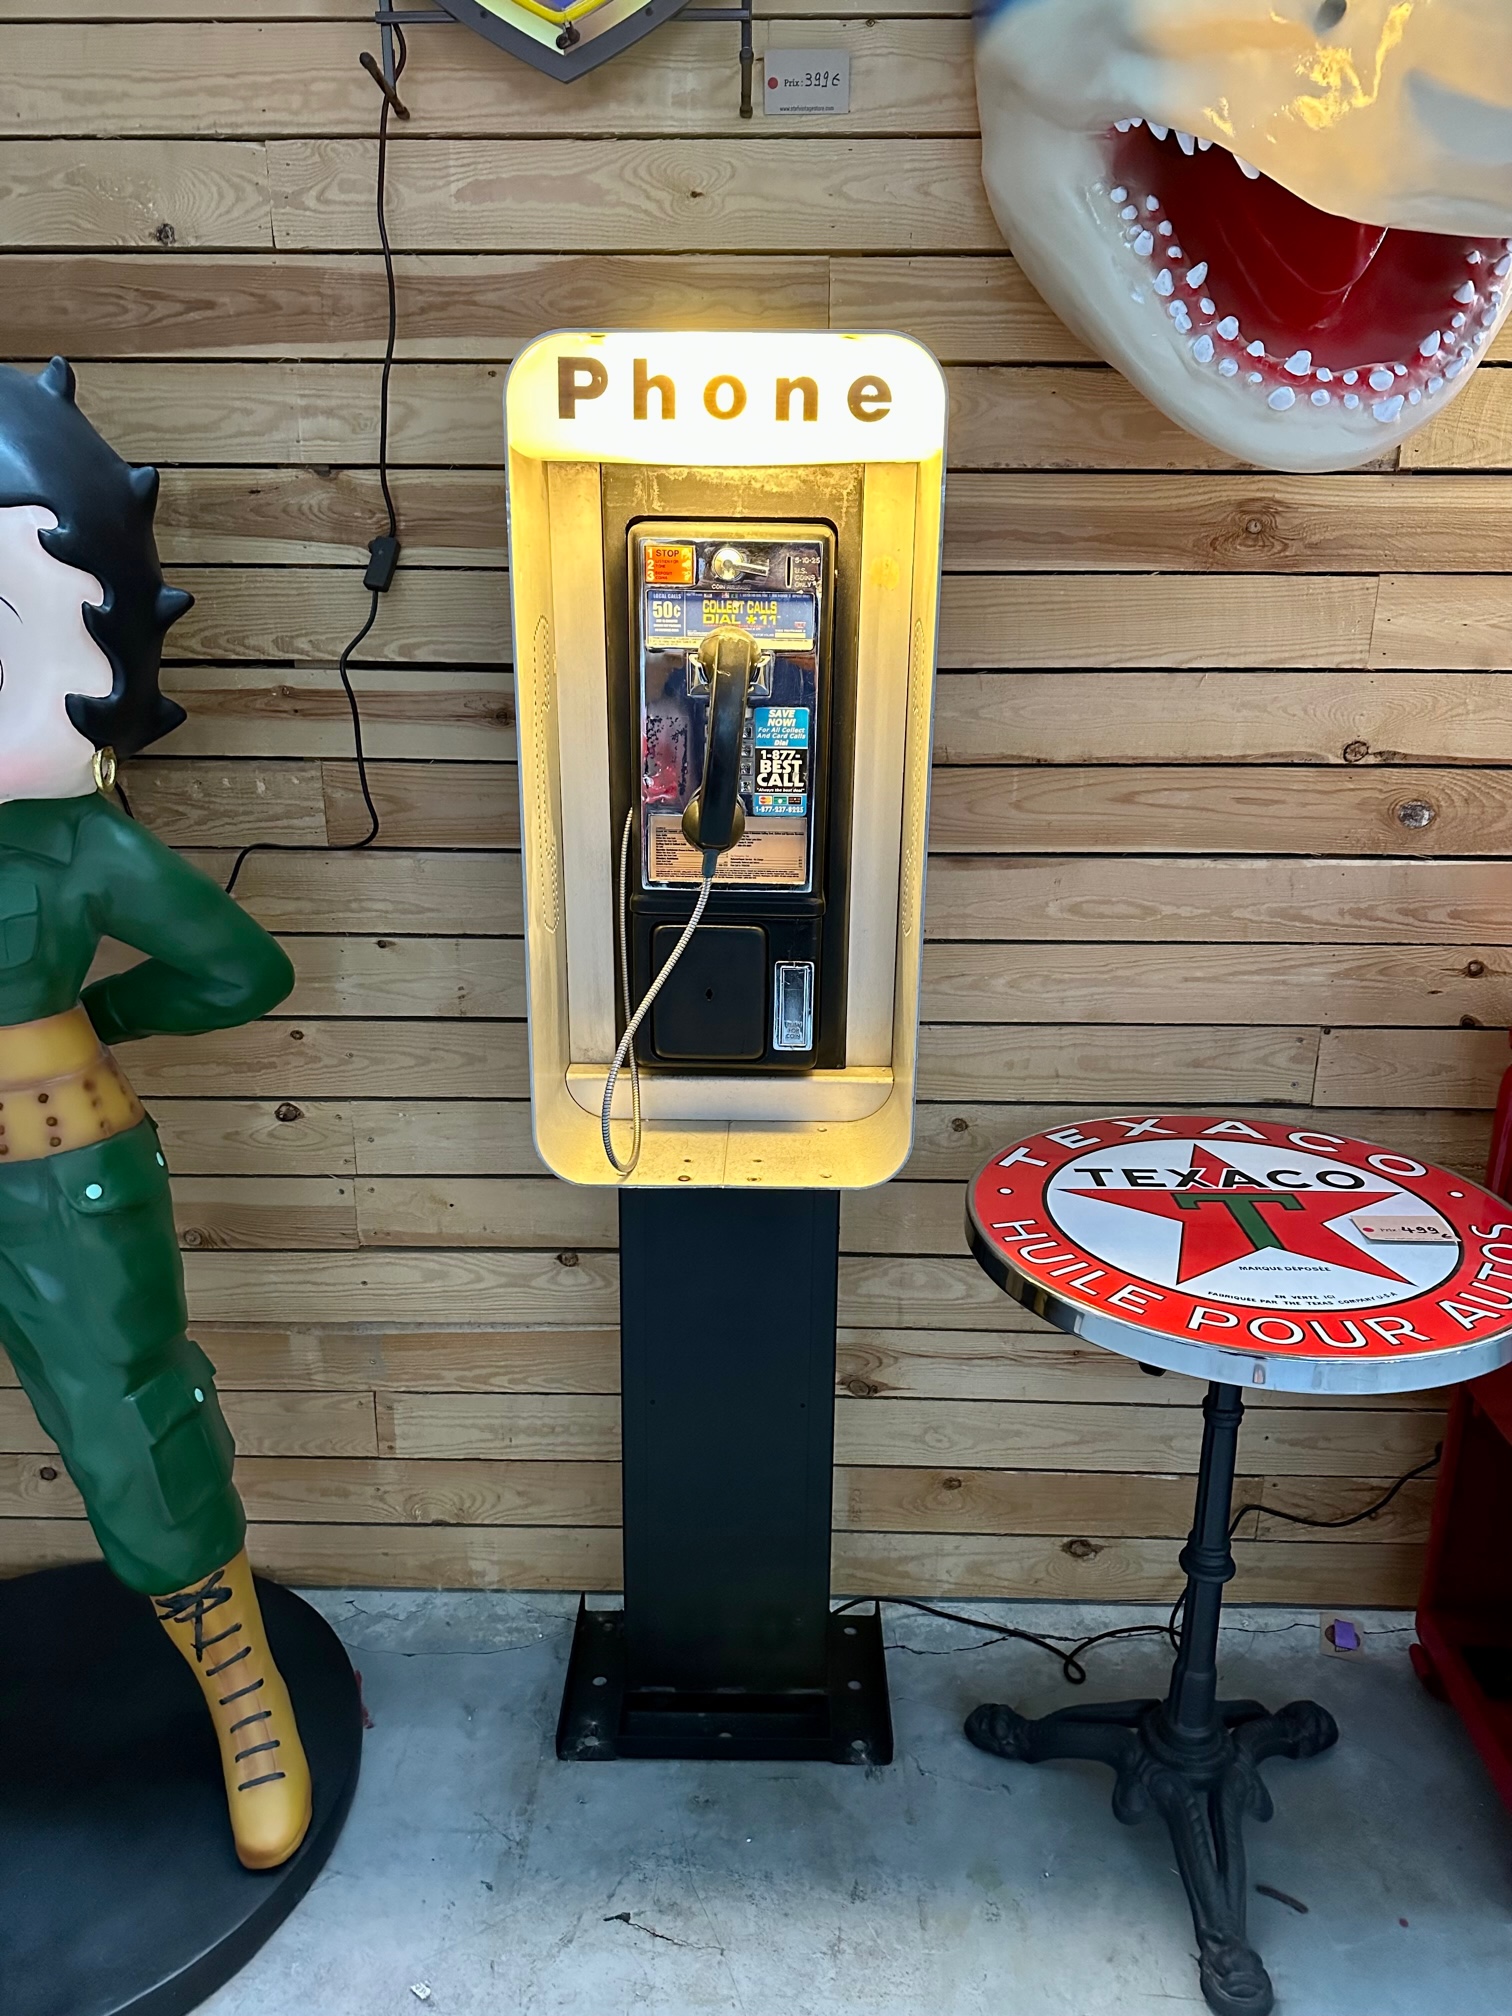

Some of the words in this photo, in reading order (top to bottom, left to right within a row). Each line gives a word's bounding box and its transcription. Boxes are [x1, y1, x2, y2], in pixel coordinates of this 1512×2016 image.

[558, 356, 892, 423] Phone
[647, 548, 653, 559] 1
[655, 549, 680, 557] STOP
[647, 559, 655, 570] 2
[647, 570, 655, 581] 3
[703, 600, 745, 614] COLLECT
[746, 600, 777, 614] CALLS
[703, 613, 742, 624] DIAL
[768, 709, 795, 718] SAVE
[767, 718, 797, 726] NOW!
[760, 750, 801, 760] 1-877-
[760, 760, 803, 774] BEST
[756, 773, 805, 787] CALL
[997, 1118, 1428, 1177] TEXACO
[1074, 1168, 1366, 1189] TEXACO
[990, 1219, 1167, 1316] HUILE
[1185, 1305, 1434, 1350] POUR
[1435, 1223, 1512, 1331] AUTOS
[1337, 1296, 1376, 1305] COMPANY
